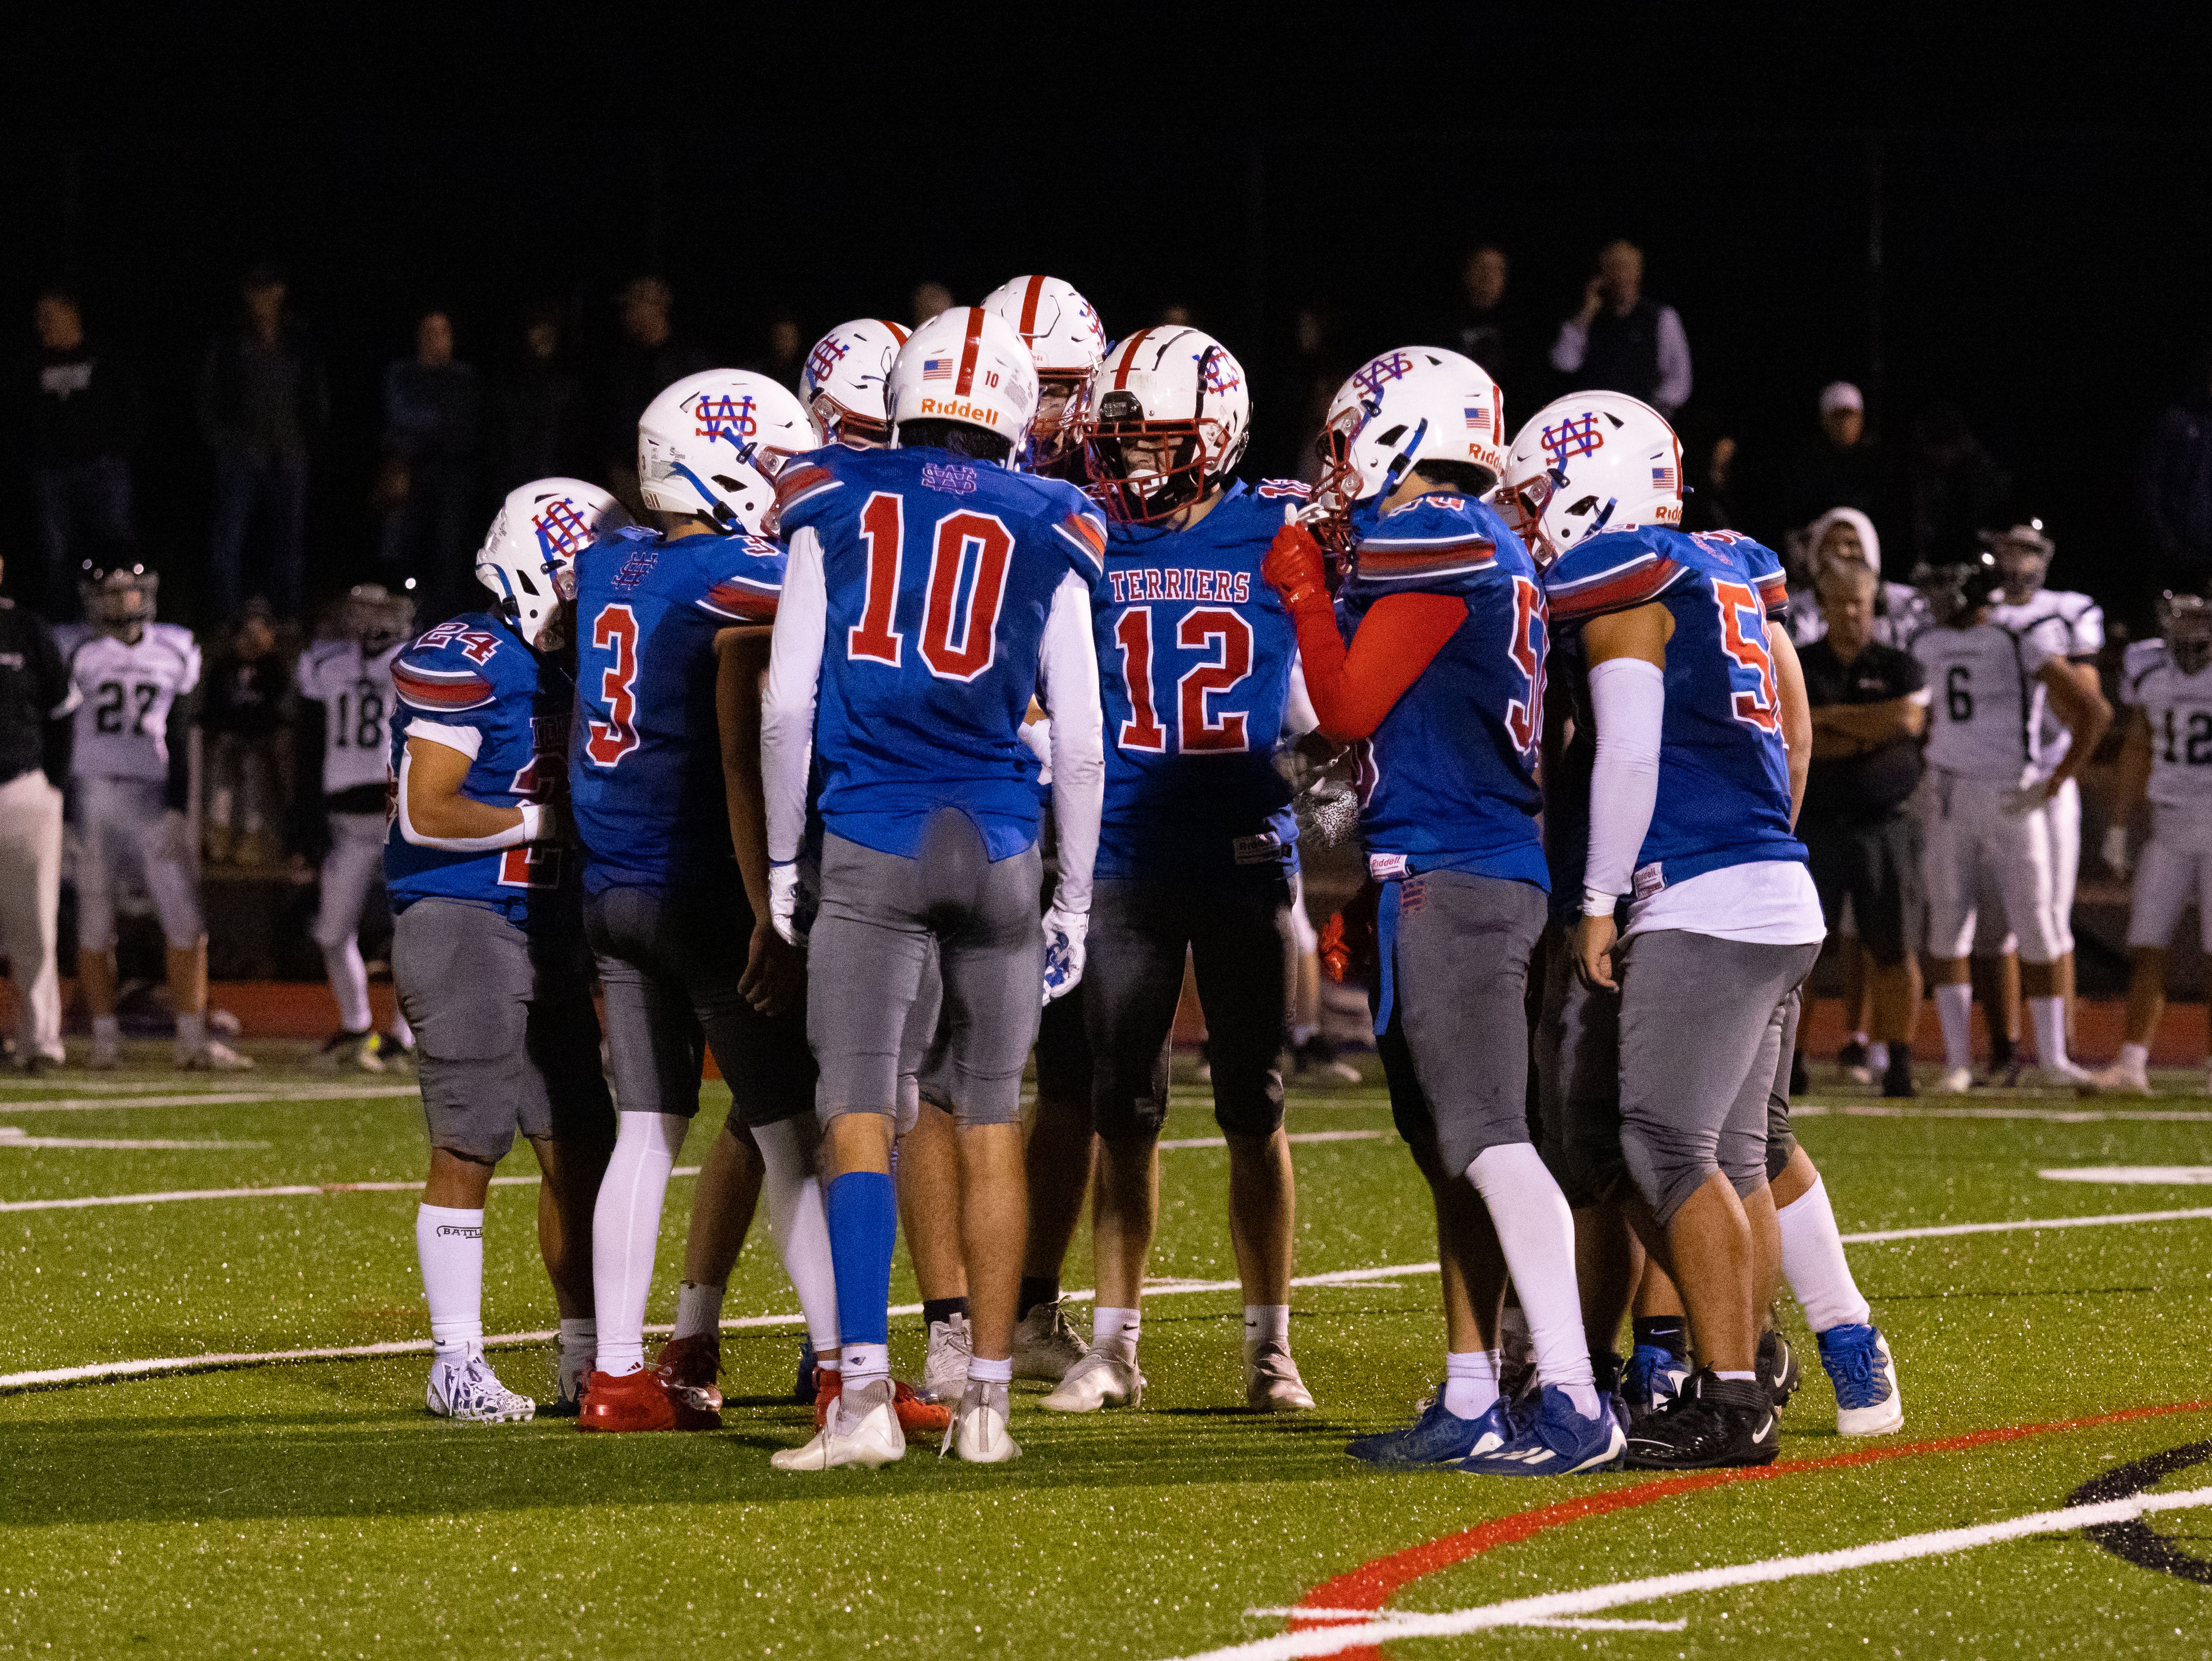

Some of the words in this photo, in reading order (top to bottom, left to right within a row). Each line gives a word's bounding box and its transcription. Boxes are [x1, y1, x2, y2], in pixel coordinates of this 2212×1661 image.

[985, 370, 999, 388] 10
[922, 398, 999, 425] Riddell
[1468, 443, 1505, 477] Ridd
[847, 490, 1016, 683] 10
[1108, 568, 1251, 604] TERRIERS
[413, 622, 504, 667] 24
[96, 680, 160, 735] 27
[586, 603, 640, 768] 3
[1113, 605, 1254, 755] 12
[1947, 666, 1974, 721] 6
[336, 693, 385, 749] 18
[2165, 708, 2212, 764] 12
[1372, 856, 1401, 868] Riddell
